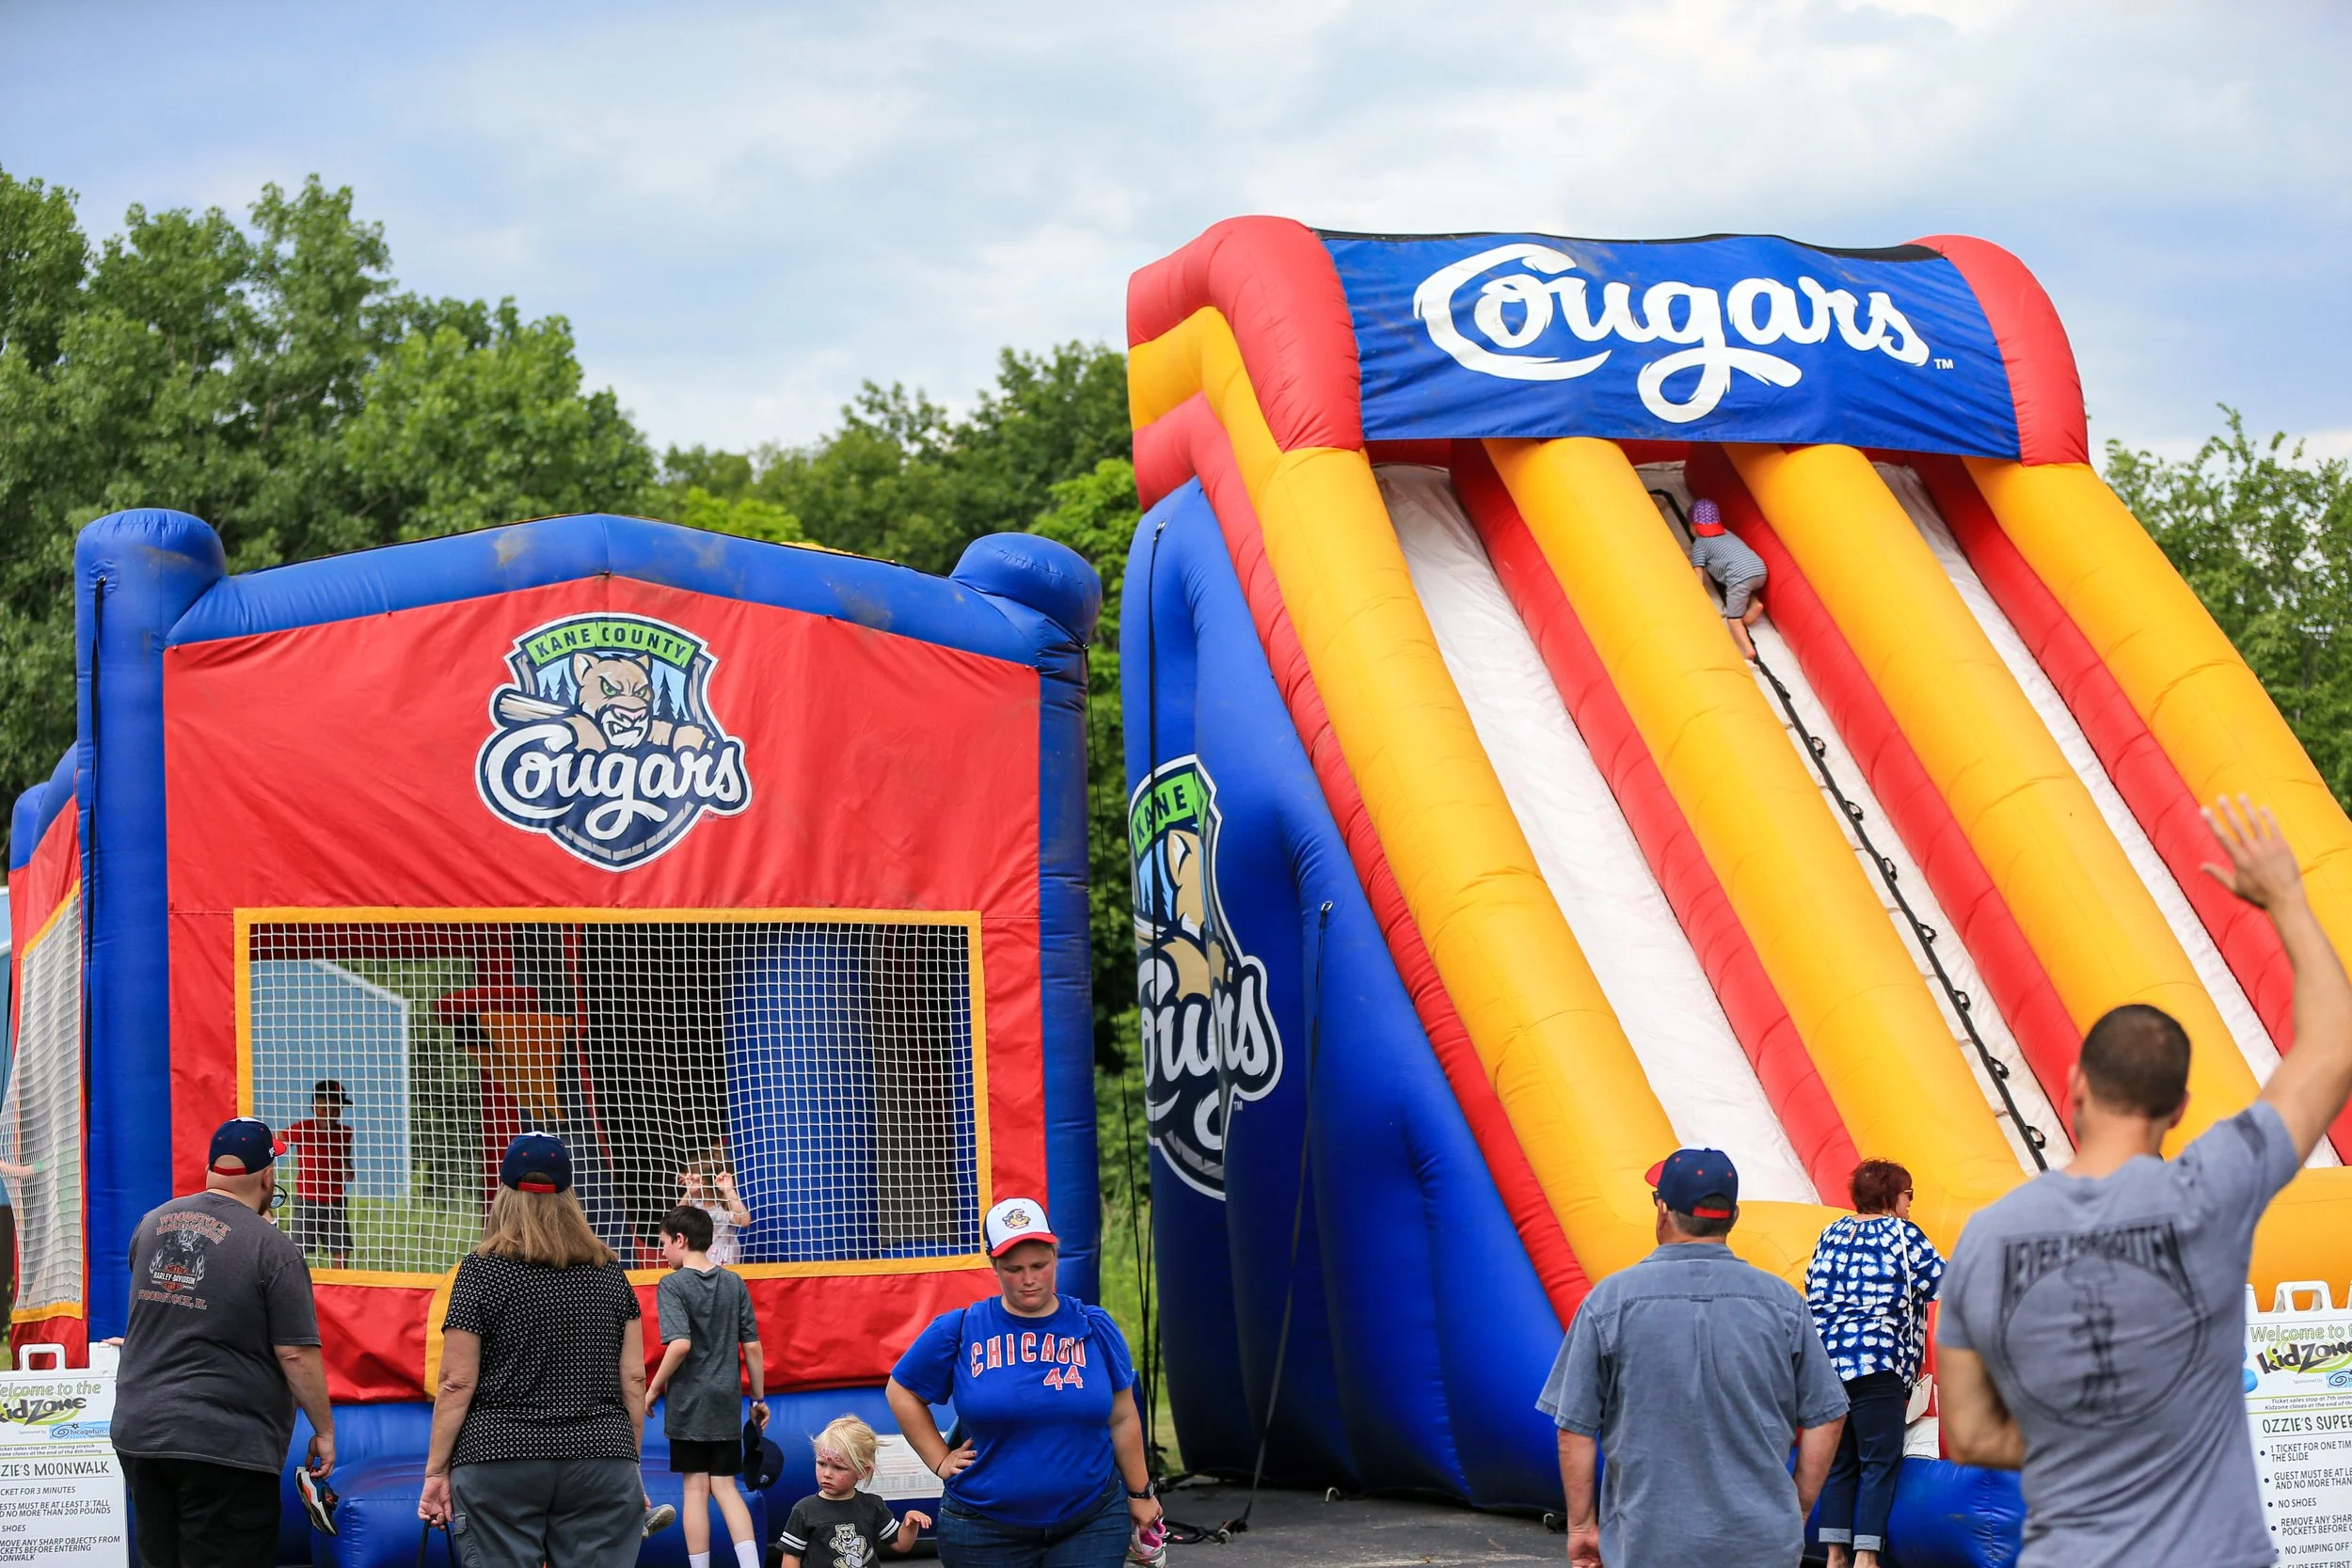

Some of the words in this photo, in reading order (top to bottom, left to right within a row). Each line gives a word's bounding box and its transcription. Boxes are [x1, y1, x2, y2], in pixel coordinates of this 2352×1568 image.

[1413, 244, 1930, 423] Cougars
[1934, 358, 1954, 370] TM
[534, 627, 590, 657] KANE
[602, 627, 689, 658] COUNTY
[485, 723, 742, 840] Cougars
[1136, 784, 1187, 844] KANE
[159, 1212, 232, 1239] WOODSTOCK
[152, 1271, 197, 1285] HARLEY-DAVIDSON
[195, 1298, 208, 1310] IL
[2250, 1325, 2325, 1342] Welcome
[2328, 1324, 2344, 1338] to
[970, 1332, 1087, 1377] CHICAGO
[1043, 1366, 1084, 1390] 44
[0, 1383, 54, 1397] elcome
[57, 1383, 73, 1395] to
[76, 1381, 102, 1395] the
[2263, 1417, 2312, 1433] OZZIE'S
[2276, 1443, 2301, 1453] TICKET
[2303, 1442, 2319, 1451] FOR
[2320, 1441, 2336, 1450] ONE
[2338, 1440, 2352, 1449] TIM
[2271, 1453, 2286, 1463] THE
[2287, 1452, 2309, 1462] SLIDE
[0, 1464, 30, 1477] ZIE'S
[34, 1461, 109, 1476] MOONWALK
[2274, 1471, 2299, 1481] GUEST
[2300, 1469, 2322, 1480] MUST
[2323, 1468, 2333, 1478] BE
[2334, 1467, 2344, 1477] AT
[2275, 1481, 2293, 1490] AND
[2294, 1480, 2306, 1489] NO
[2307, 1478, 2329, 1488] MORE
[2331, 1477, 2352, 1486] THAN
[42, 1486, 76, 1495] MINUTES
[0, 1503, 16, 1512] ESTS
[40, 1501, 50, 1510] BE
[61, 1500, 84, 1509] LEAST
[92, 1499, 109, 1508] TALL
[2278, 1499, 2290, 1508] NO
[2291, 1497, 2317, 1508] SHOES
[6, 1510, 18, 1518] NO
[79, 1507, 111, 1515] POUNDS
[2280, 1516, 2313, 1527] REMOVE
[2314, 1514, 2330, 1525] ANY
[2331, 1513, 2352, 1524] SHAR
[1, 1524, 26, 1532] SHOES
[2282, 1525, 2317, 1536] POCKETS
[2318, 1523, 2347, 1534] BEFORE
[0, 1539, 21, 1547] MOVE
[98, 1535, 120, 1544] FROM
[0, 1546, 23, 1555] CKETS
[24, 1545, 54, 1554] BEFORE
[55, 1544, 91, 1553] ENTERING
[2285, 1545, 2296, 1555] NO
[2298, 1543, 2333, 1554] JUMPING
[2334, 1542, 2350, 1552] OFF
[0, 1554, 35, 1562] ONWALK
